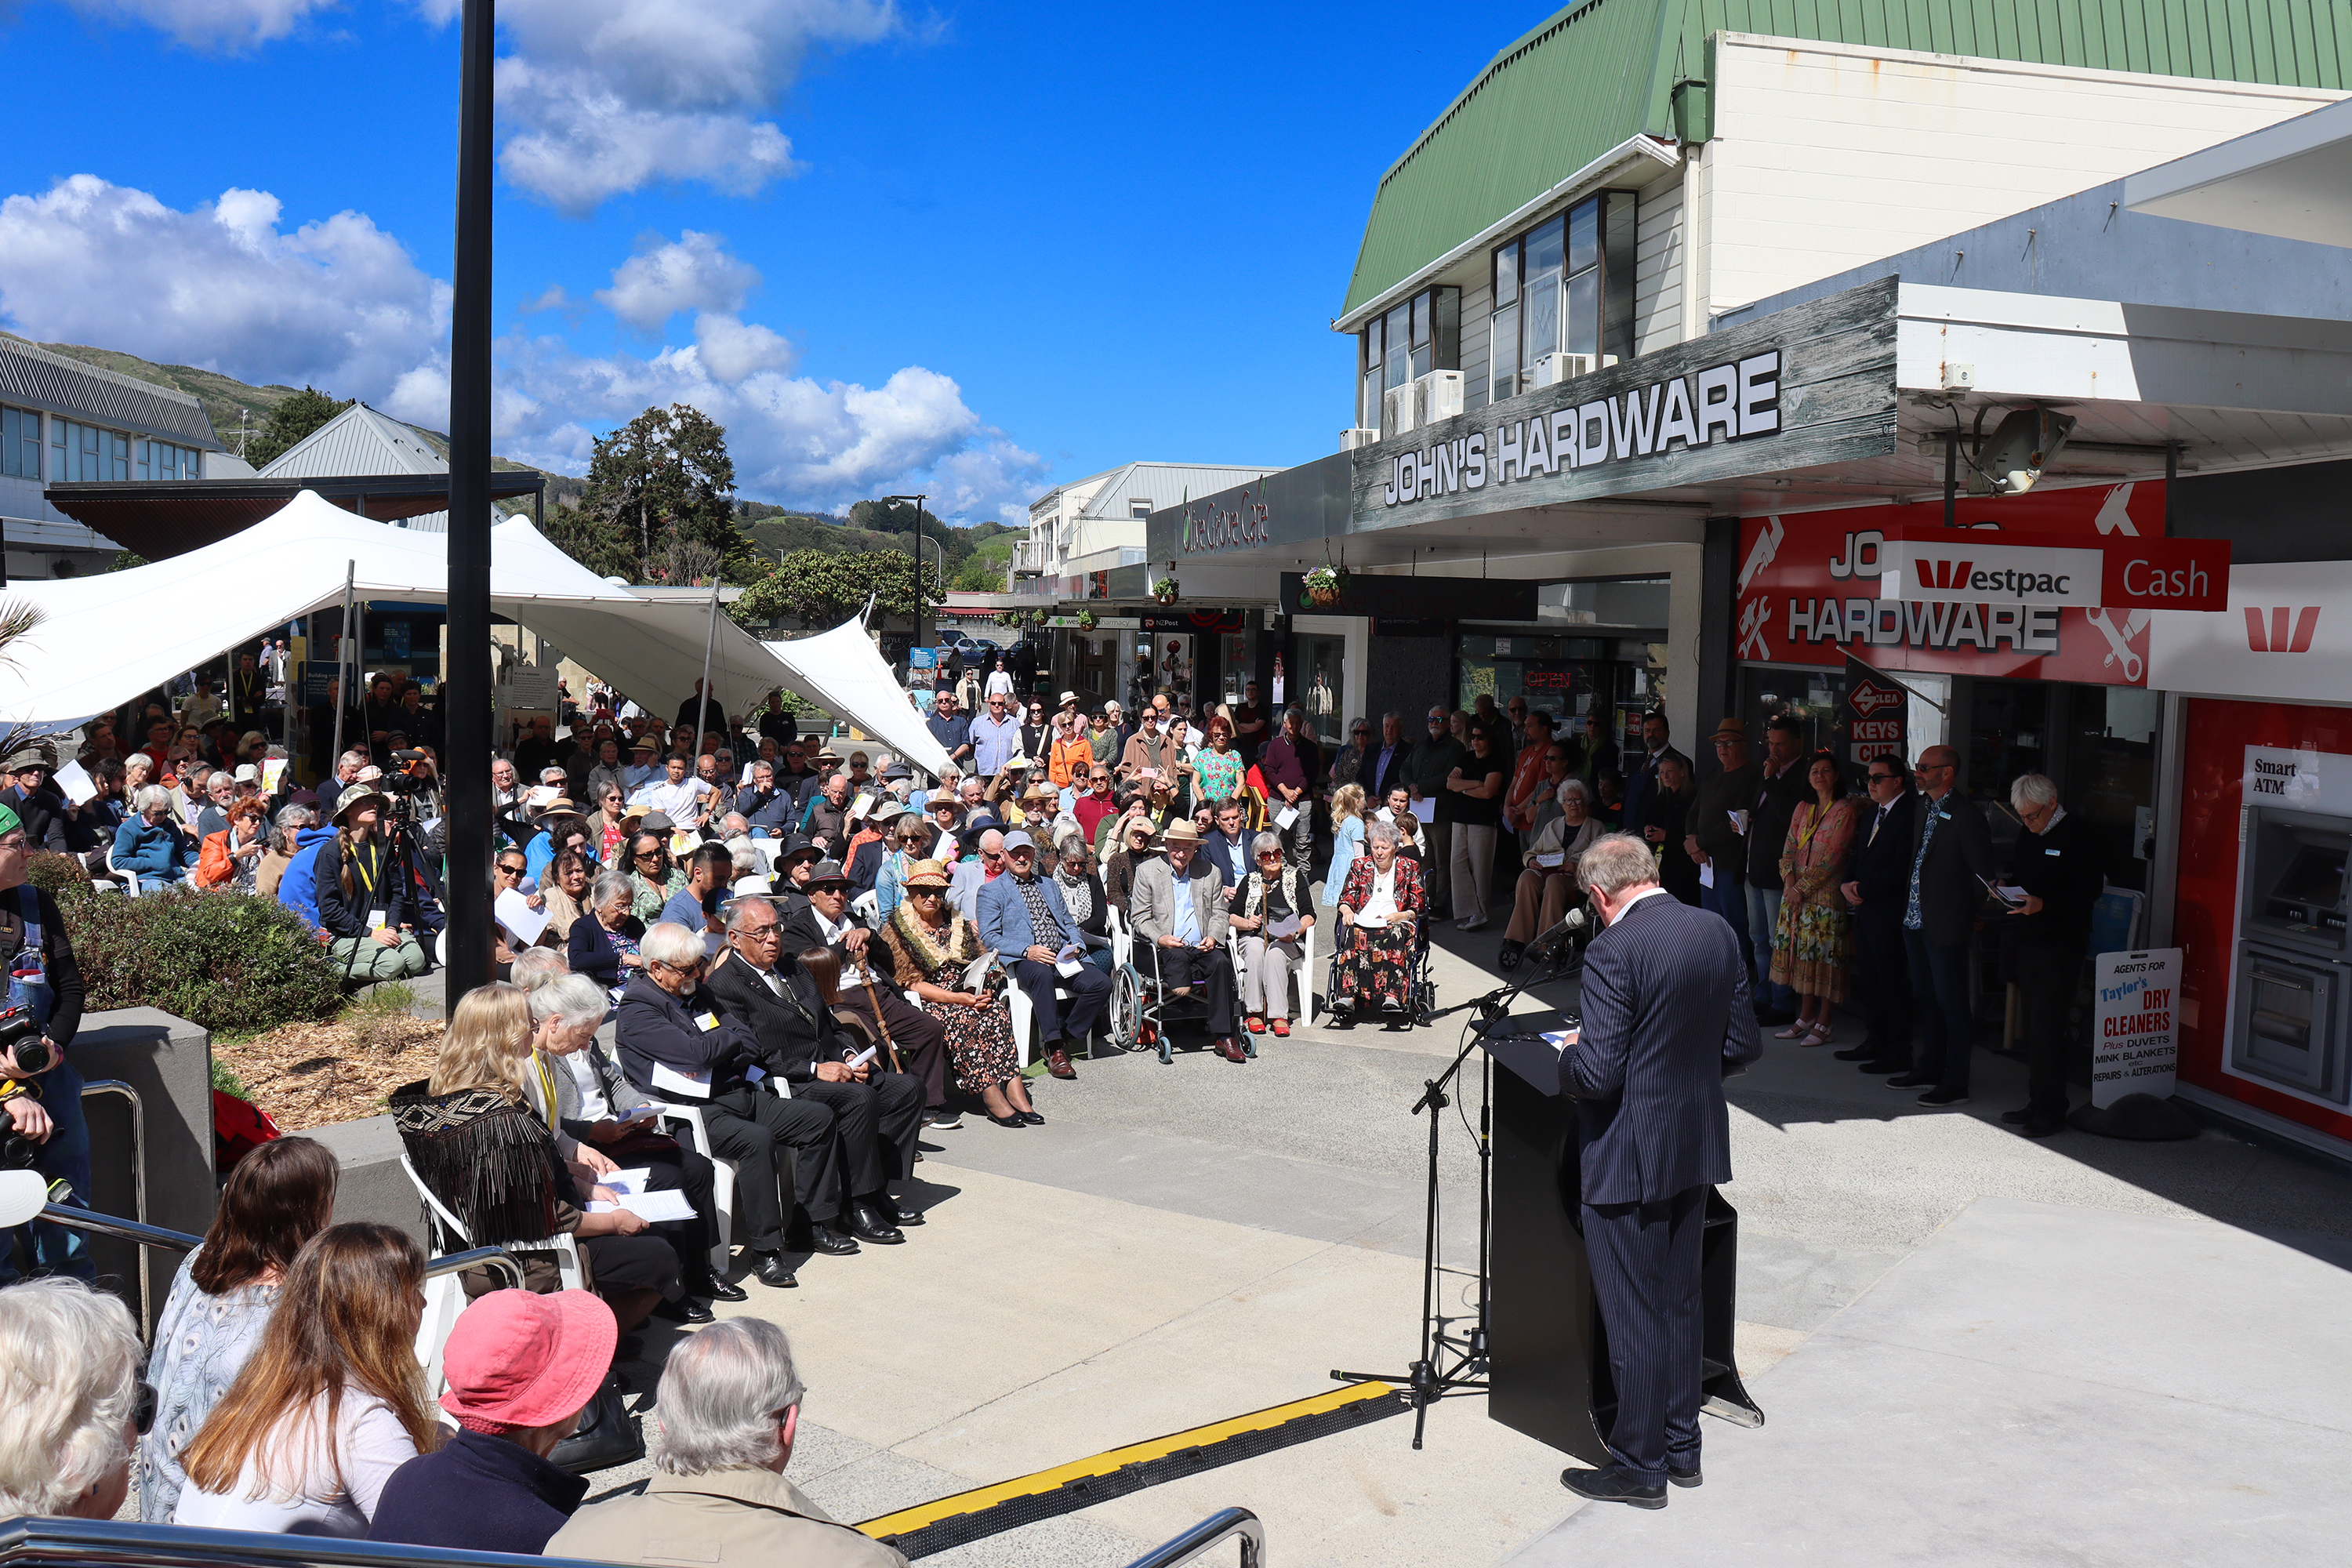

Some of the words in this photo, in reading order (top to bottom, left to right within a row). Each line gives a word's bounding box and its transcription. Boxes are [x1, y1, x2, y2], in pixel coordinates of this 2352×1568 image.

[1385, 432, 1486, 507] JOHN'S
[1497, 350, 1781, 484] HARDWARE
[1206, 502, 1239, 549] Grove
[1915, 559, 2071, 596] Westpac
[2123, 558, 2209, 597] Cash
[1297, 588, 1367, 613] Ove
[1377, 589, 1457, 615] Grove
[1788, 599, 2061, 654] HARDWARE
[1526, 672, 1571, 688] OPEN
[1853, 721, 1899, 739] KEYS
[2255, 758, 2296, 777] Smart
[2253, 778, 2285, 795] ATM
[2114, 963, 2146, 975] AGENTS
[2148, 961, 2165, 971] FOR
[2100, 977, 2148, 1002] Taylor's
[2143, 989, 2171, 1011] DRY
[2103, 1011, 2170, 1037] CLEANERS
[2103, 1041, 2124, 1051] Plus
[2127, 1035, 2169, 1048] DUVETS
[2095, 1054, 2120, 1064] MINK
[2123, 1047, 2176, 1061] BLANKETS
[2093, 1070, 2122, 1083] REPAIRS
[2132, 1063, 2176, 1077] ALTERATIONS
